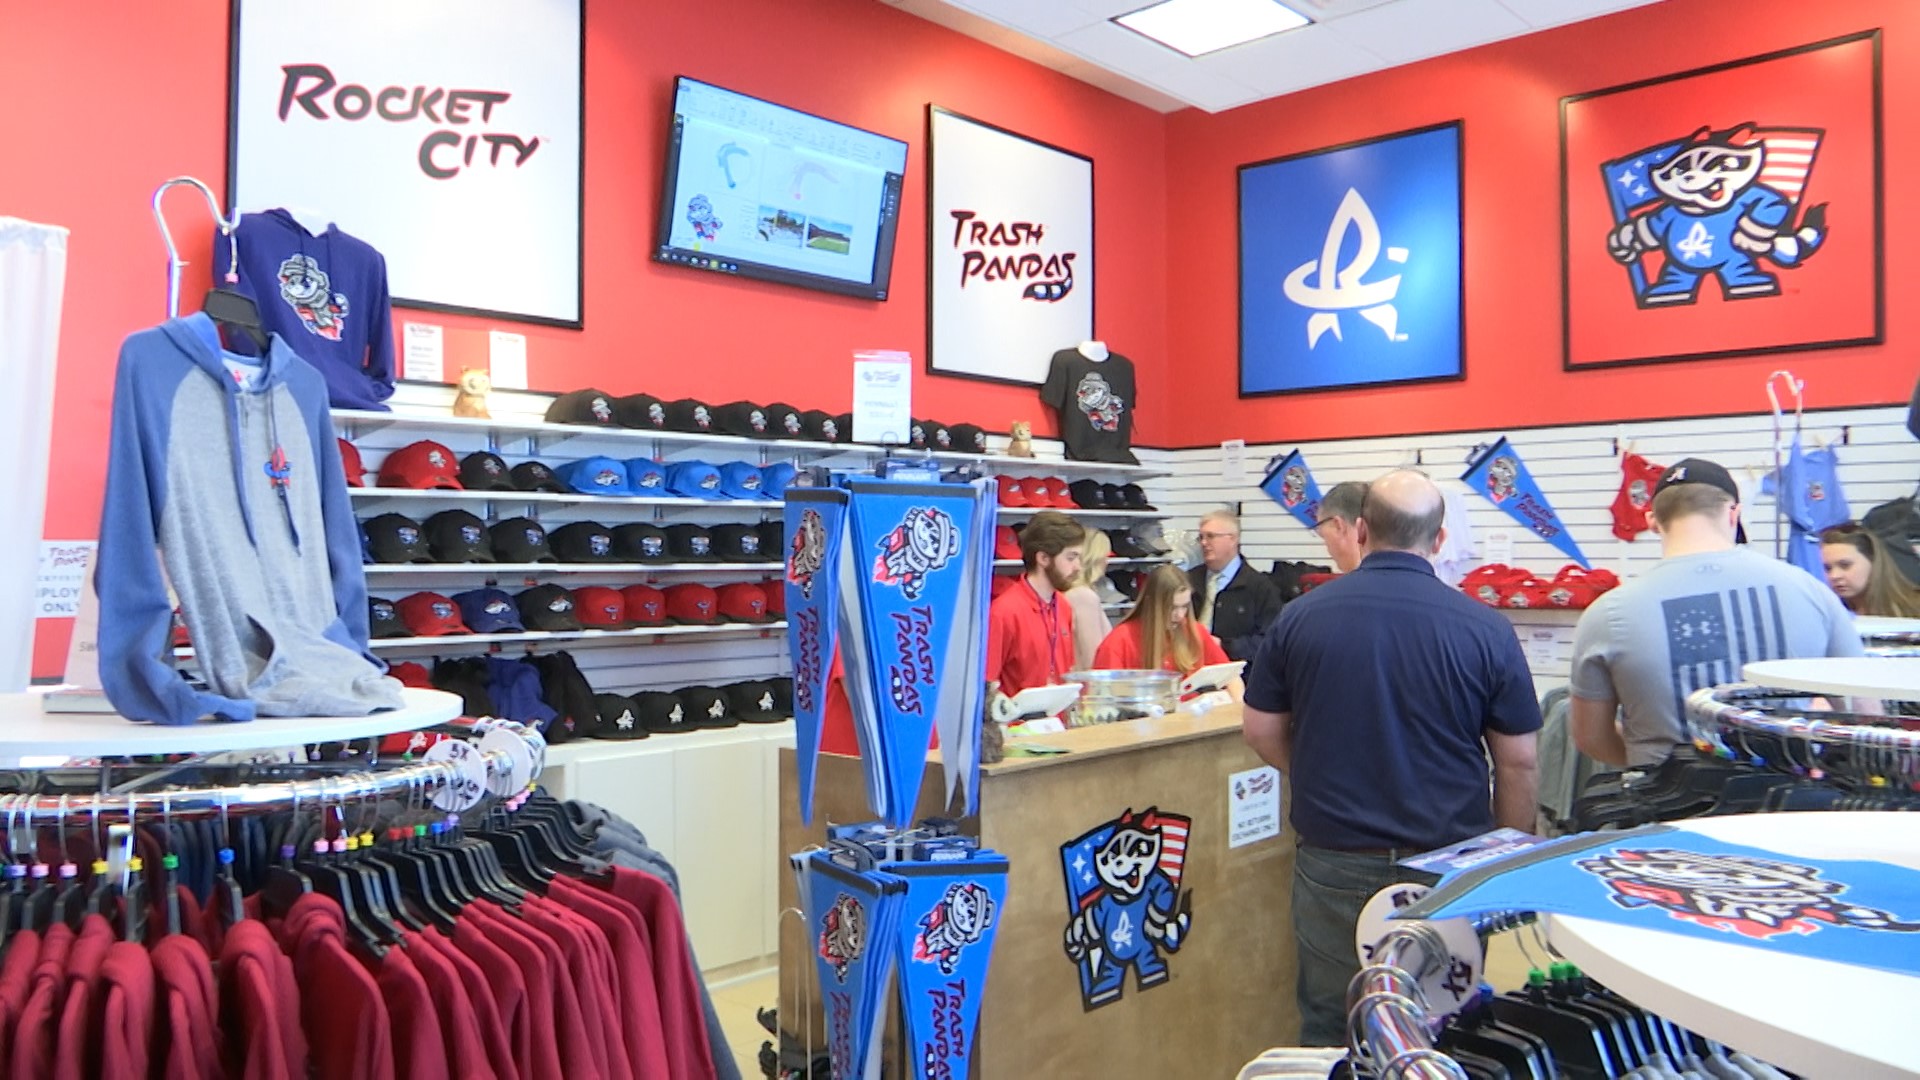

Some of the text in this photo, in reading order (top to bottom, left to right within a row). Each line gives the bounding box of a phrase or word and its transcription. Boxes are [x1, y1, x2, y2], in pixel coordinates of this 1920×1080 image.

[278, 63, 512, 123] ROCKET
[418, 129, 540, 181] CITY
[950, 210, 1044, 248] TRASH
[962, 250, 1077, 303] PANDAS
[890, 612, 923, 716] PANDAS
[910, 604, 935, 685] TRASH
[924, 988, 953, 1079] PANDA
[946, 977, 966, 1057] TRASH
